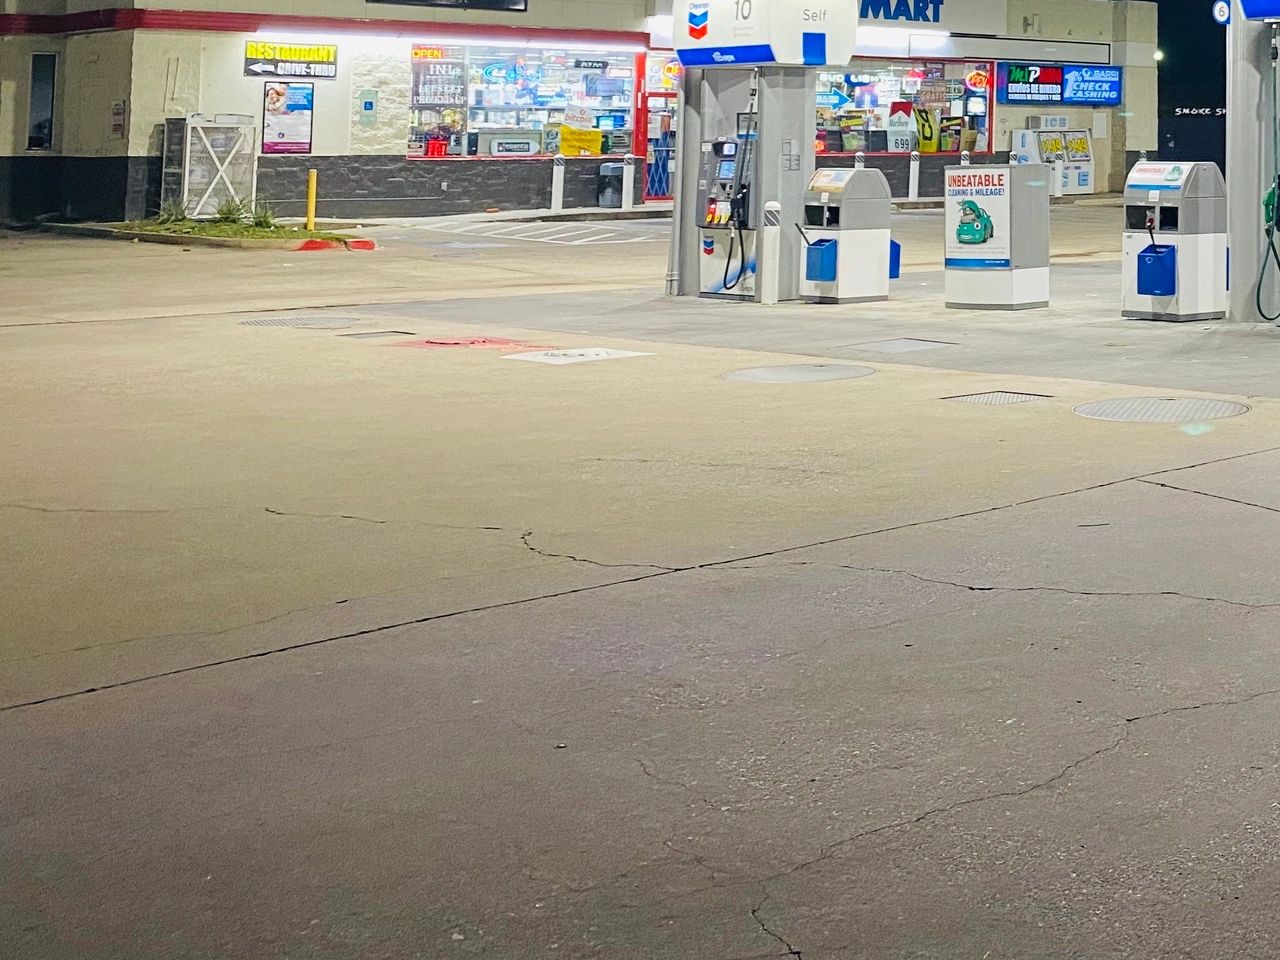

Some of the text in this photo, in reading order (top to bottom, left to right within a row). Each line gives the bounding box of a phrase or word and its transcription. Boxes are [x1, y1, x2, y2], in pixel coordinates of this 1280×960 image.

[803, 9, 828, 22] Self
[1219, 6, 1225, 17] 6
[247, 42, 336, 62] RESTAURANT
[412, 48, 442, 59] OPEN
[277, 62, 336, 76] DRIVE-THRU
[1073, 82, 1111, 91] CHECK
[1071, 91, 1118, 99] CASHING
[1175, 108, 1211, 116] SMOKE
[1045, 117, 1067, 128] ICE
[895, 139, 909, 149] 699
[948, 174, 1004, 187] UNBEATABLE
[948, 189, 969, 197] CLEANING
[975, 188, 1004, 196] MILEAGE!
